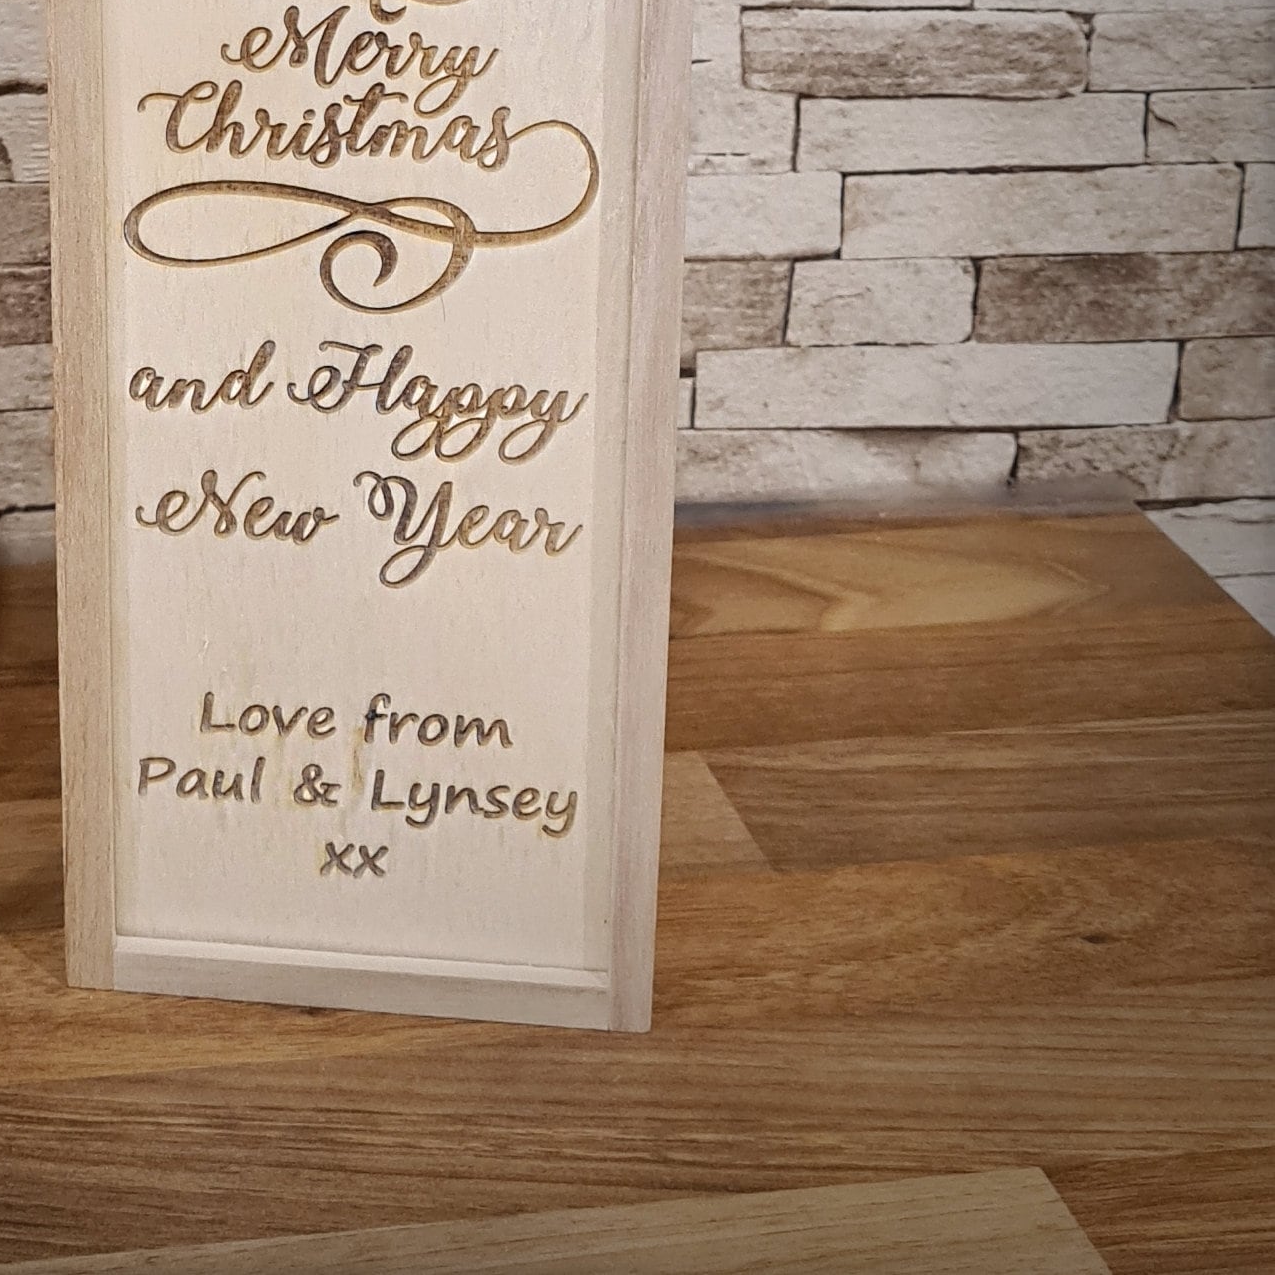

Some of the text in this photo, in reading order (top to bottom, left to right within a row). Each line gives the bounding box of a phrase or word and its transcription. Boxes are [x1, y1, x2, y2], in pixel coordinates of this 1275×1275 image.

[220, 4, 500, 118] Merry
[137, 79, 513, 172] Christmas
[128, 340, 589, 466] and Happy
[135, 469, 584, 590] New Year
[199, 690, 514, 750] Love from
[137, 755, 578, 839] Paul & Lynsey
[319, 840, 390, 879] xx
